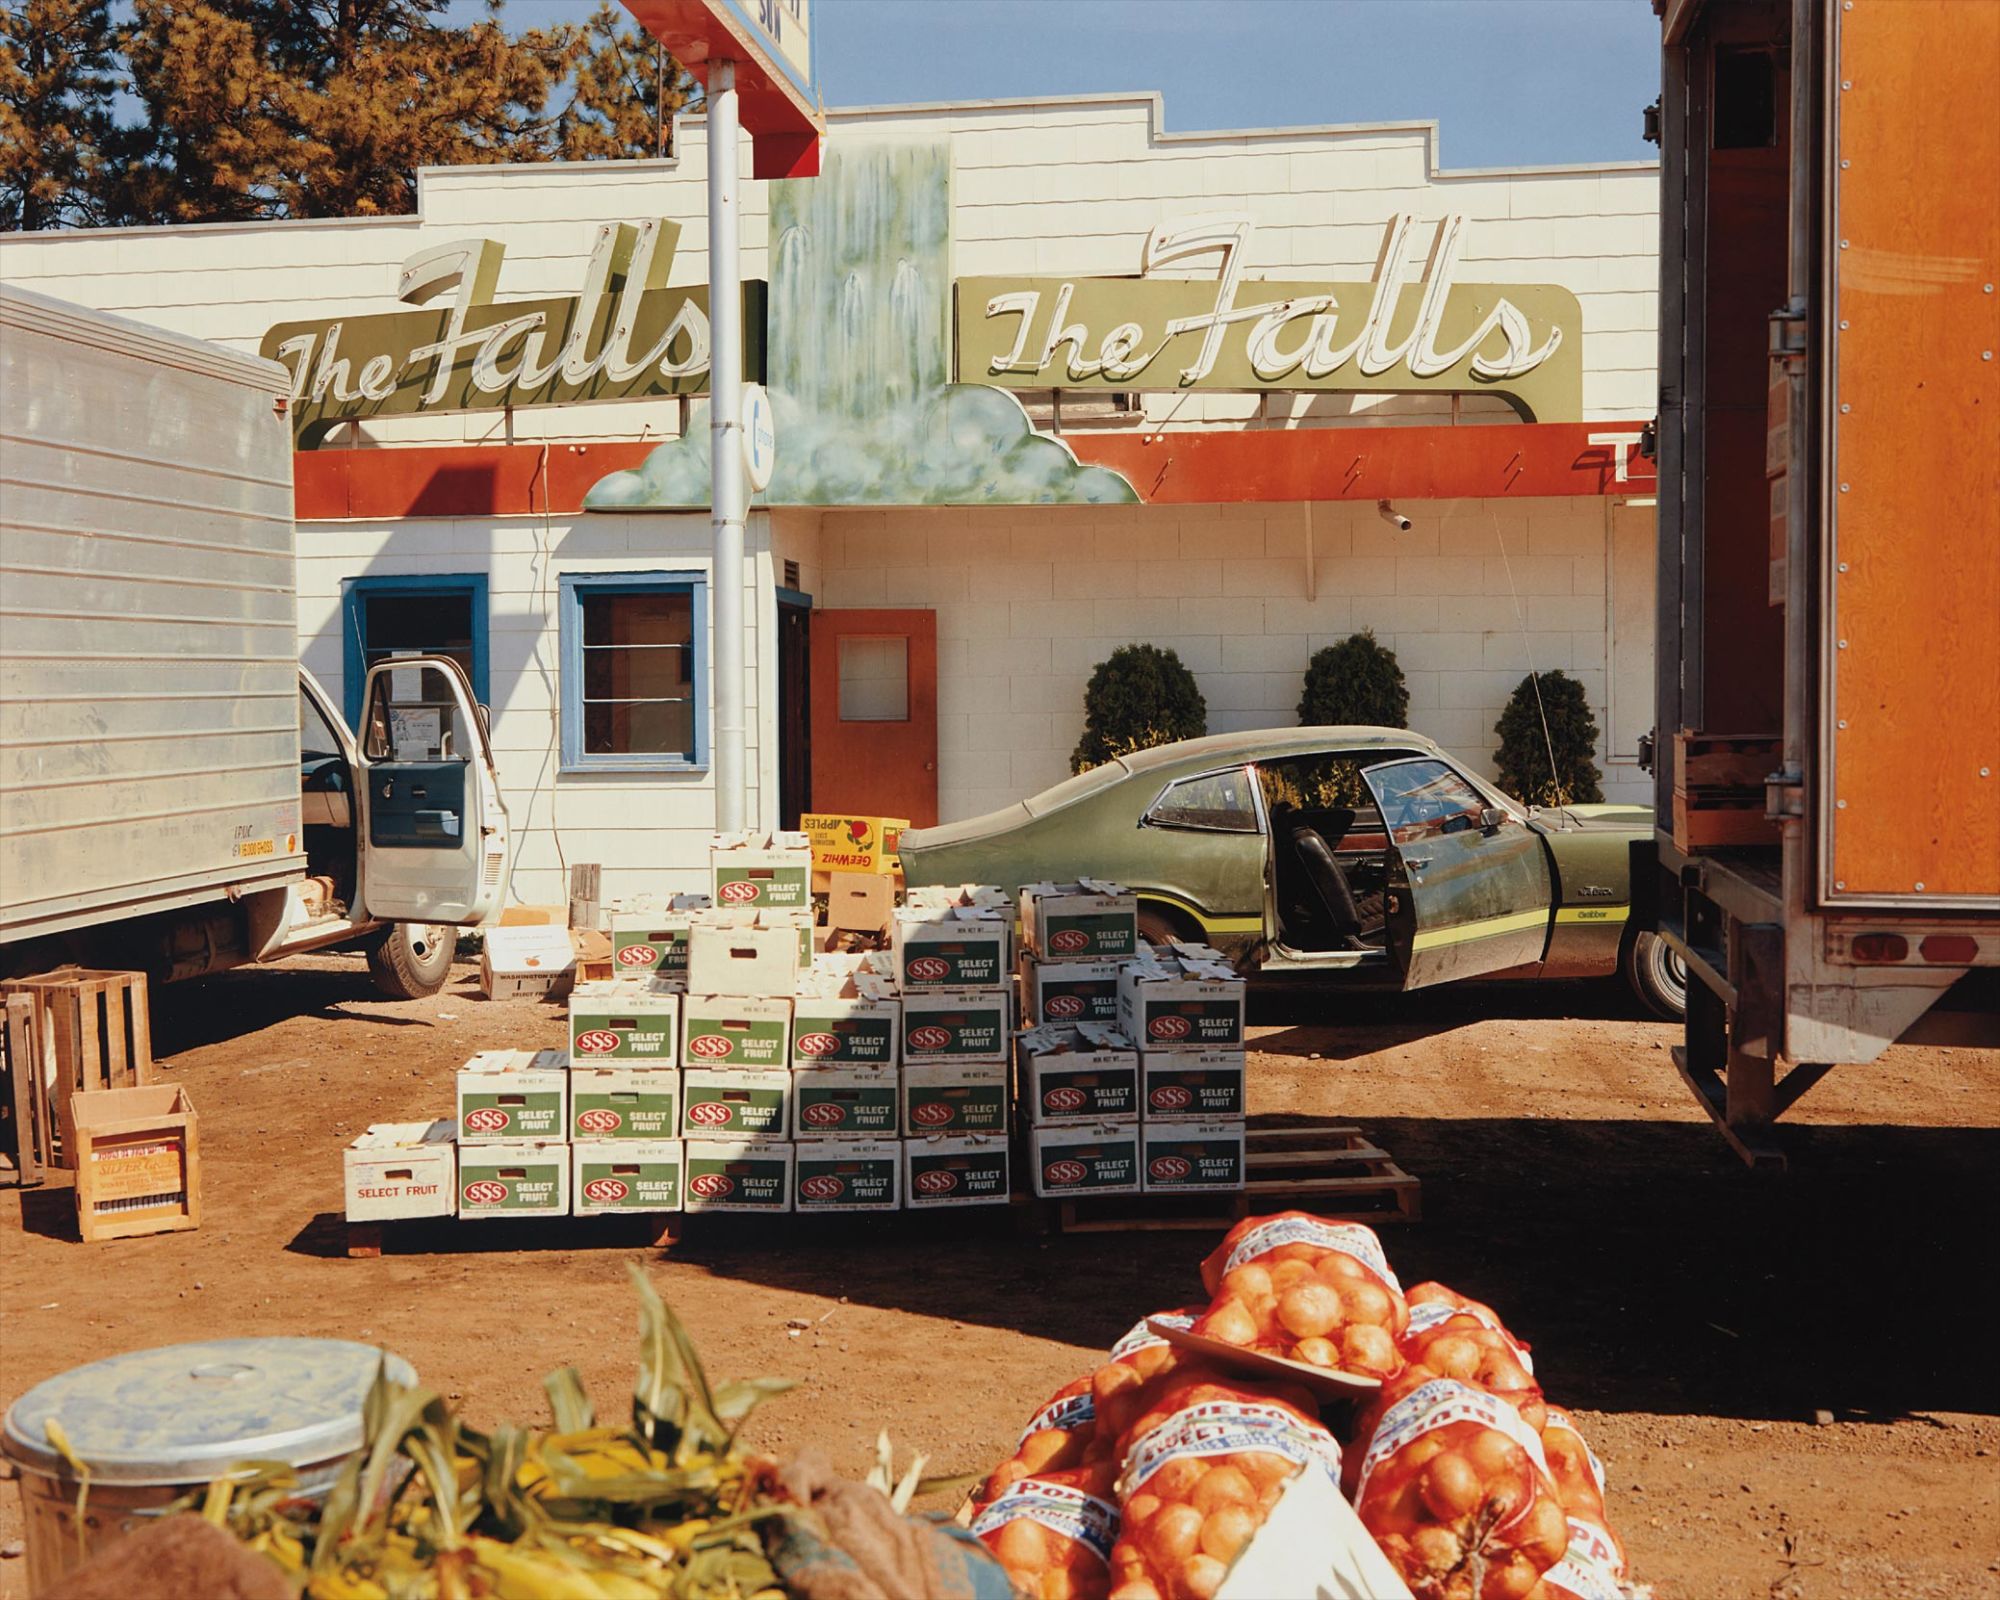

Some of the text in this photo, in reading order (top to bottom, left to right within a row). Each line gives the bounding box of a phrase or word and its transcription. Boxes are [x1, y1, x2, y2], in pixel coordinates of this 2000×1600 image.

[985, 211, 1563, 386] The Falls
[277, 217, 711, 405] The Falls
[725, 884, 753, 899] SSS
[767, 884, 800, 892] SELECT
[770, 892, 796, 900] FRUIT
[1096, 930, 1128, 939] SELECT
[1057, 933, 1083, 948] SSS
[1100, 940, 1125, 948] FRUIT
[664, 946, 688, 954] SELE
[623, 948, 653, 963] SSS
[914, 960, 944, 976] SSS
[958, 960, 994, 968] SELECT
[961, 969, 990, 978] FRUIT
[1052, 998, 1079, 1013] SSS
[1155, 1019, 1184, 1034] SSS
[1199, 1019, 1234, 1027] SELECT
[915, 1029, 945, 1044] SSS
[959, 1028, 995, 1037] SELECT
[1202, 1028, 1229, 1037] FRUIT
[582, 1033, 613, 1048] SSS
[628, 1033, 665, 1042] SELECT
[849, 1037, 885, 1045] SELECT
[631, 1042, 660, 1052] FRUIT
[696, 1037, 727, 1054] SSS
[741, 1039, 778, 1048] SELECT
[804, 1036, 833, 1052] SSS
[962, 1038, 990, 1047] FRUIT
[744, 1049, 773, 1058] FRUIT
[851, 1047, 880, 1055] FRUIT
[1094, 1088, 1130, 1097] SELECT
[1157, 1089, 1186, 1105] SSS
[1200, 1088, 1235, 1097] SELECT
[1050, 1090, 1080, 1106] SSS
[1098, 1098, 1125, 1107] FRUIT
[1203, 1098, 1230, 1106] FRUIT
[740, 1106, 777, 1116] SELECT
[853, 1106, 890, 1114] SELECT
[918, 1105, 948, 1120] SSS
[962, 1104, 998, 1113] SELECT
[518, 1110, 555, 1120] SELECT
[629, 1112, 667, 1121] SELECT
[695, 1105, 726, 1122] SSS
[809, 1106, 839, 1122] SSS
[471, 1111, 502, 1128] SSS
[584, 1112, 615, 1128] SSS
[743, 1117, 772, 1126] FRUIT
[856, 1116, 885, 1124] FRUIT
[965, 1114, 994, 1123] FRUIT
[521, 1120, 550, 1130] FRUIT
[632, 1122, 662, 1131] FRUIT
[1094, 1160, 1130, 1170] SELECT
[1156, 1159, 1185, 1175] SSS
[1199, 1159, 1234, 1167] SELECT
[965, 1170, 1000, 1180] SELECT
[1051, 1163, 1080, 1179] SSS
[1098, 1170, 1126, 1179] FRUIT
[1202, 1169, 1230, 1177] FRUIT
[636, 1181, 674, 1191] SELECT
[697, 1176, 728, 1193] SSS
[742, 1178, 779, 1187] SELECT
[852, 1178, 888, 1187] SELECT
[920, 1173, 950, 1190] SSS
[968, 1181, 996, 1190] FRUIT
[358, 1185, 438, 1198] SELECT FRUIT
[470, 1183, 502, 1200] SSS
[516, 1182, 554, 1192] SELECT
[591, 1182, 622, 1198] SSS
[807, 1179, 838, 1195] SSS
[640, 1192, 669, 1200] FRUIT
[745, 1188, 774, 1197] FRUIT
[855, 1188, 884, 1196] FRUIT
[520, 1193, 549, 1202] FRUIT
